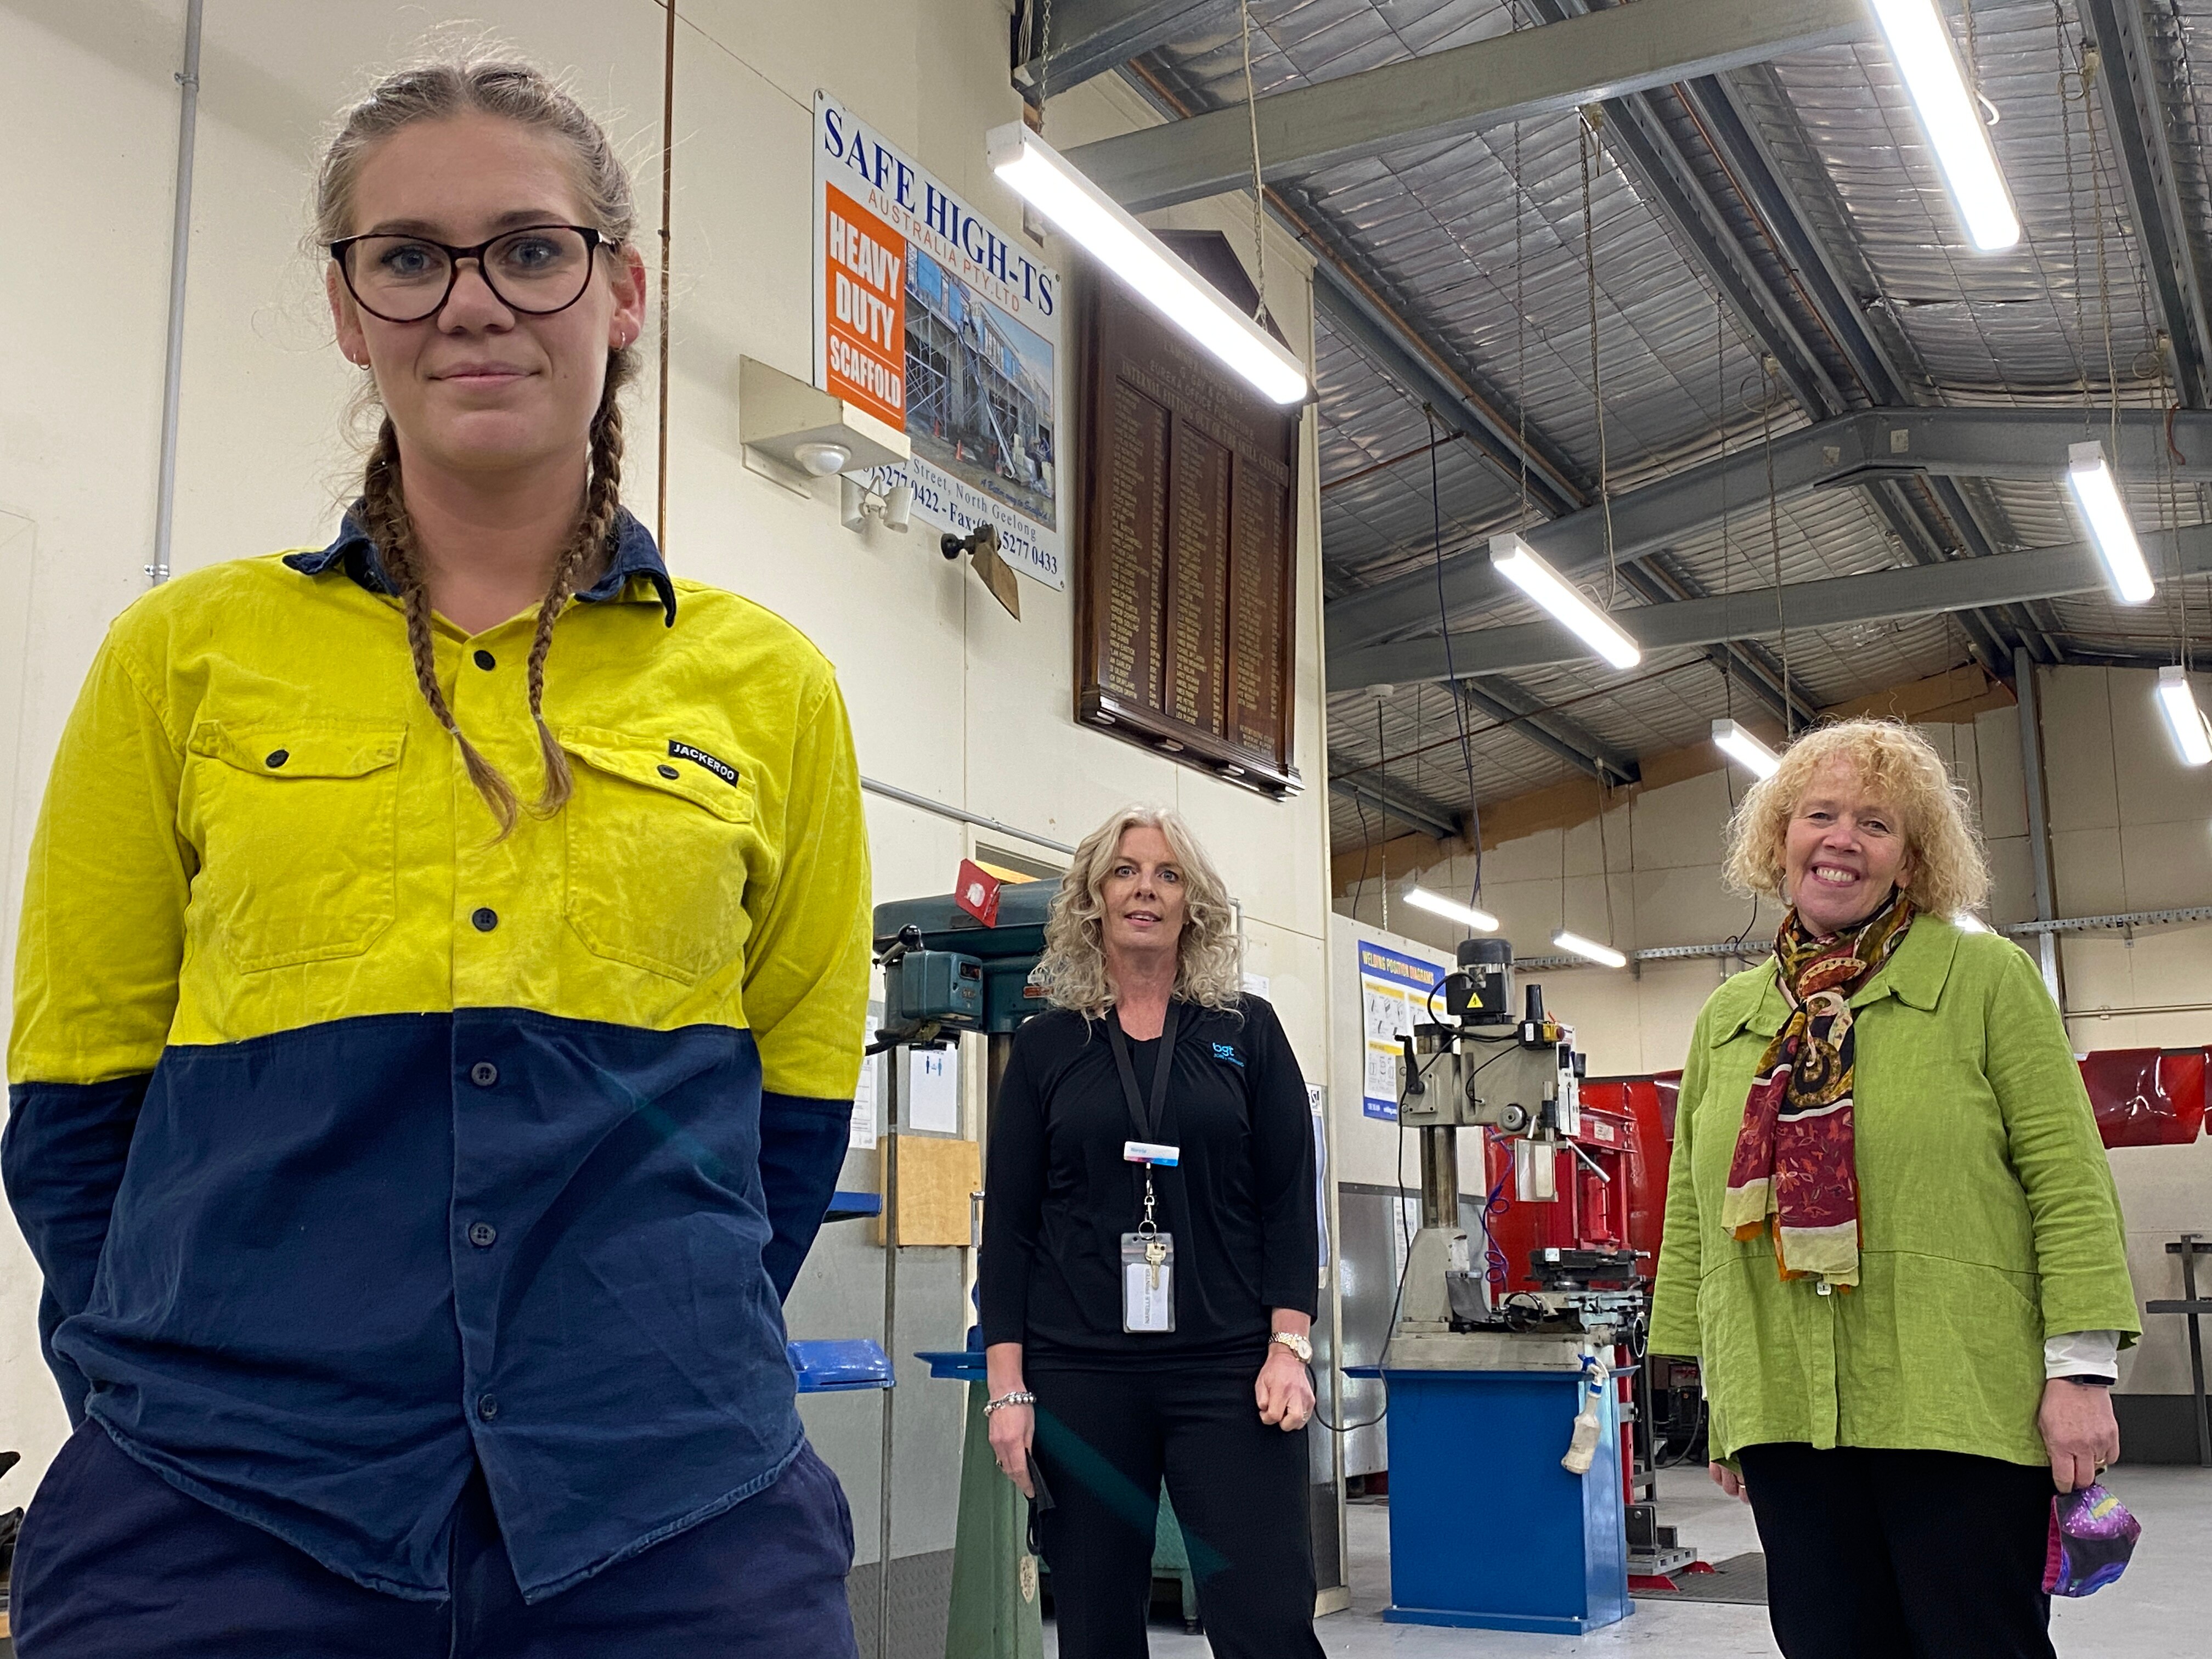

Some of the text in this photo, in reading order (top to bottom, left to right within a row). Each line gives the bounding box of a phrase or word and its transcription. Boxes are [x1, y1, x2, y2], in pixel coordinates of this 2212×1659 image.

[825, 108, 1053, 316] SAFE HIGH-TS
[868, 189, 1019, 312] AUSTRALIA PTY LTD
[830, 210, 901, 300] HEAVY
[836, 271, 895, 352] DUTY
[830, 335, 901, 409] SCAFFOLD
[911, 480, 939, 513] 0422
[1002, 531, 1029, 559] 5277
[1032, 546, 1057, 574] 0433
[956, 483, 987, 513] North
[992, 504, 1036, 541] Geelong
[674, 744, 734, 780] JACKEROO
[1212, 1042, 1234, 1056] bgt
